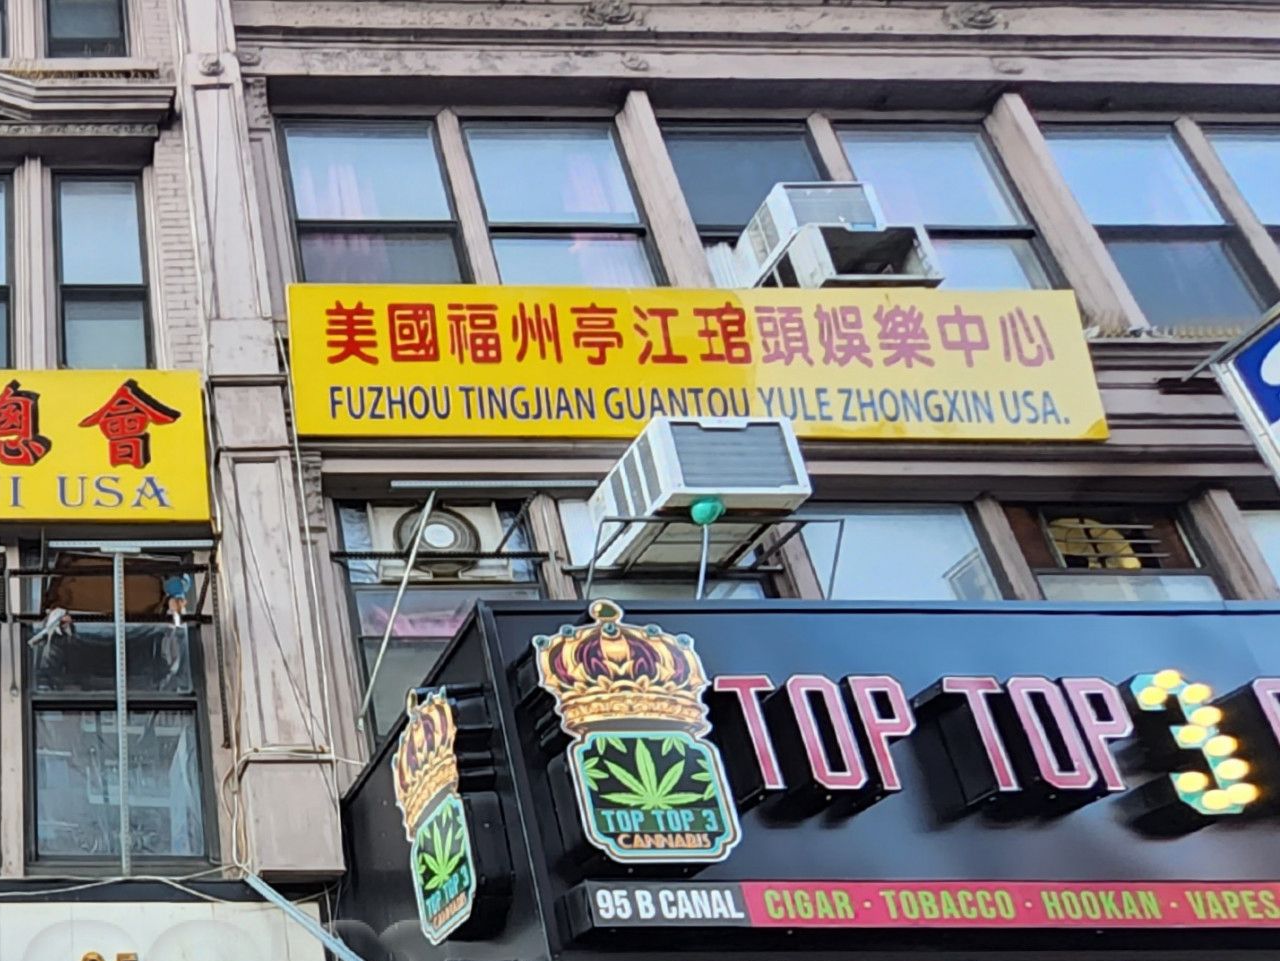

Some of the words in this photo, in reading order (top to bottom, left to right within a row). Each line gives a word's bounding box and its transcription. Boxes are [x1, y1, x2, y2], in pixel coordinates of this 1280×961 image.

[329, 385, 451, 422] FUZHOU
[460, 386, 595, 422] TINGJIAN
[603, 386, 751, 422] GUANTOU
[758, 387, 835, 422] YULE
[841, 387, 995, 425] ZHONGXIN
[1002, 389, 1071, 426] USA.
[58, 474, 174, 508] USA
[714, 674, 916, 792] TOP
[943, 674, 1134, 792] TOP
[1129, 668, 1260, 815] 3
[601, 809, 644, 832] TOP
[651, 809, 695, 832] TOP
[701, 809, 718, 832] 3
[617, 833, 712, 849] CANNABIS
[597, 890, 631, 921] 95
[636, 890, 656, 921] B
[657, 890, 745, 922] CANAL
[766, 890, 855, 921] CIGAR
[880, 890, 1016, 921] TOBACCO
[1040, 890, 1162, 920] HOOKAN
